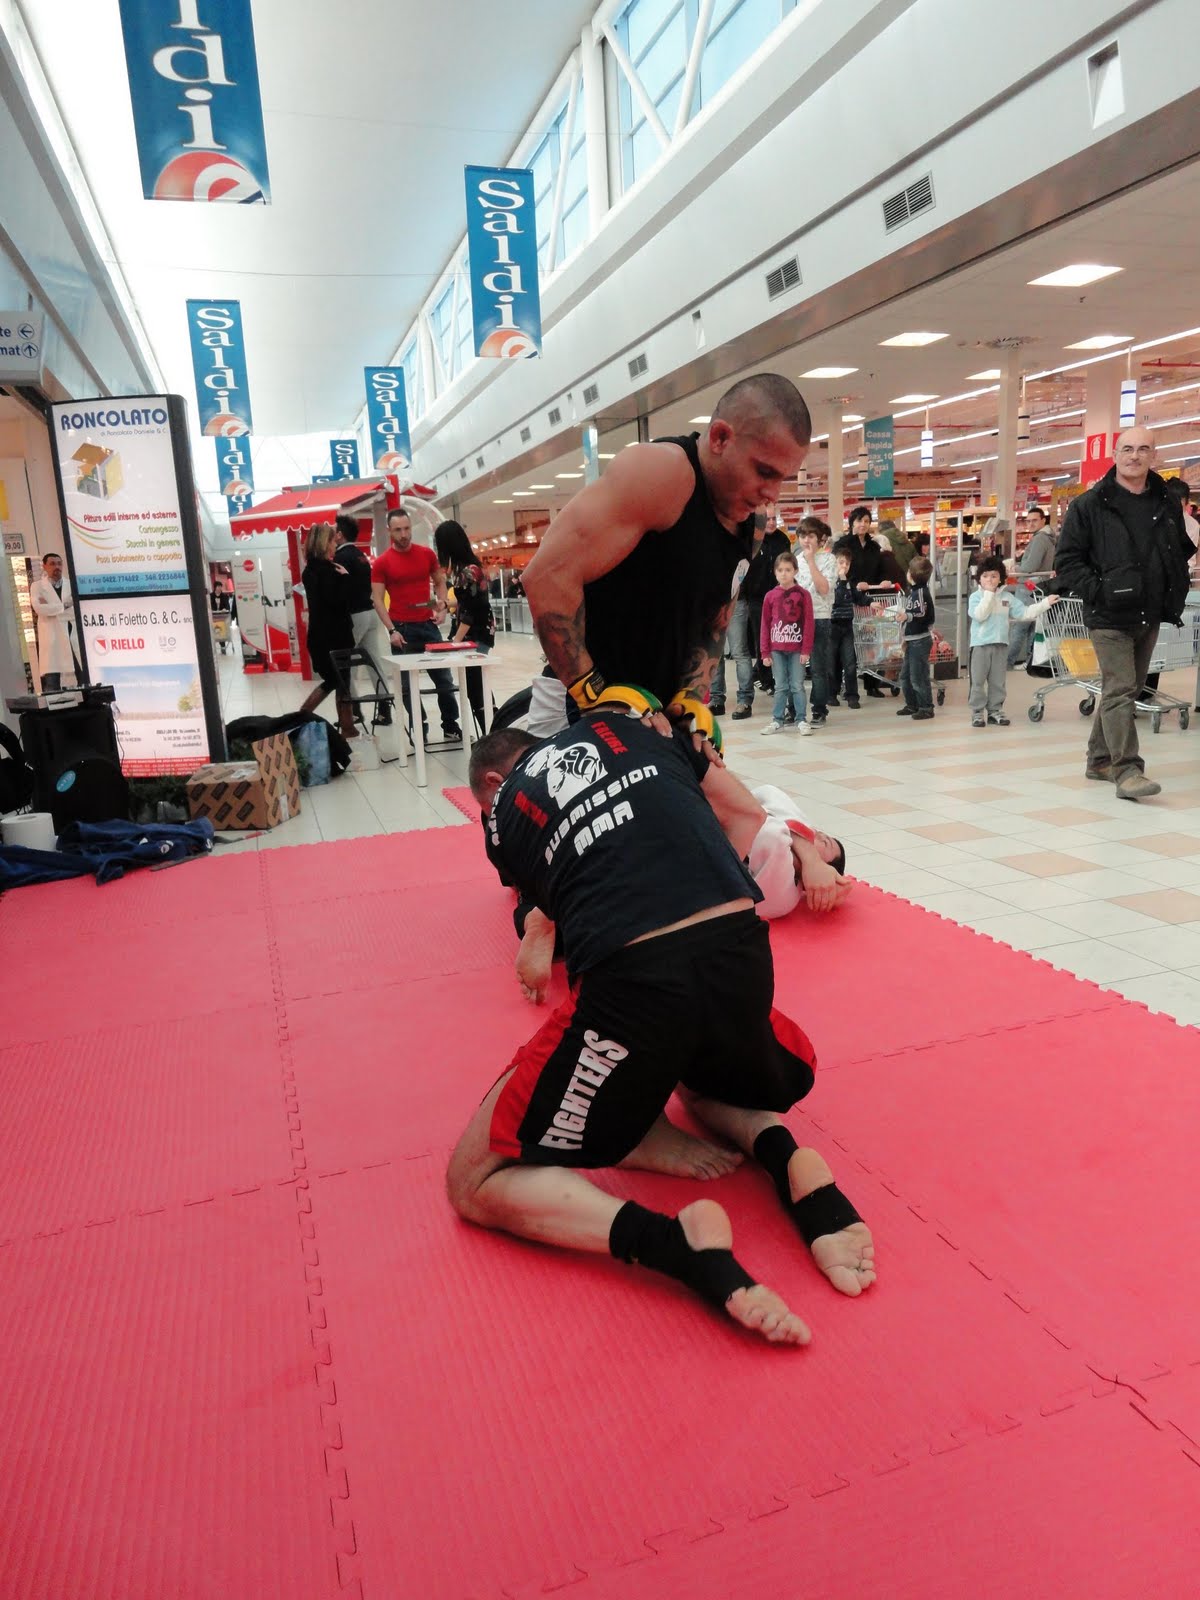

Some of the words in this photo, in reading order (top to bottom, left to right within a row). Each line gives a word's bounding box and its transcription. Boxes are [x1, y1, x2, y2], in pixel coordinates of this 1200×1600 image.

[477, 179, 528, 329] Saldi
[196, 308, 240, 415] Saldi
[61, 408, 168, 430] RONCOLATO
[372, 372, 403, 453] Saldi
[884, 452, 893, 460] 10
[141, 510, 151, 520] ed
[152, 510, 178, 519] esterne
[138, 525, 179, 536] Cartongesso
[156, 539, 181, 550] genere
[153, 551, 183, 563] cappotto
[83, 613, 108, 627] S.A.B.
[110, 613, 118, 626] di
[118, 612, 148, 626] Foletto
[149, 611, 160, 625] G.
[162, 611, 169, 624] &
[170, 610, 181, 624] C.
[111, 638, 145, 650] RIELLO
[573, 800, 635, 857] MMA
[537, 1029, 630, 1150] FIGHTERS
